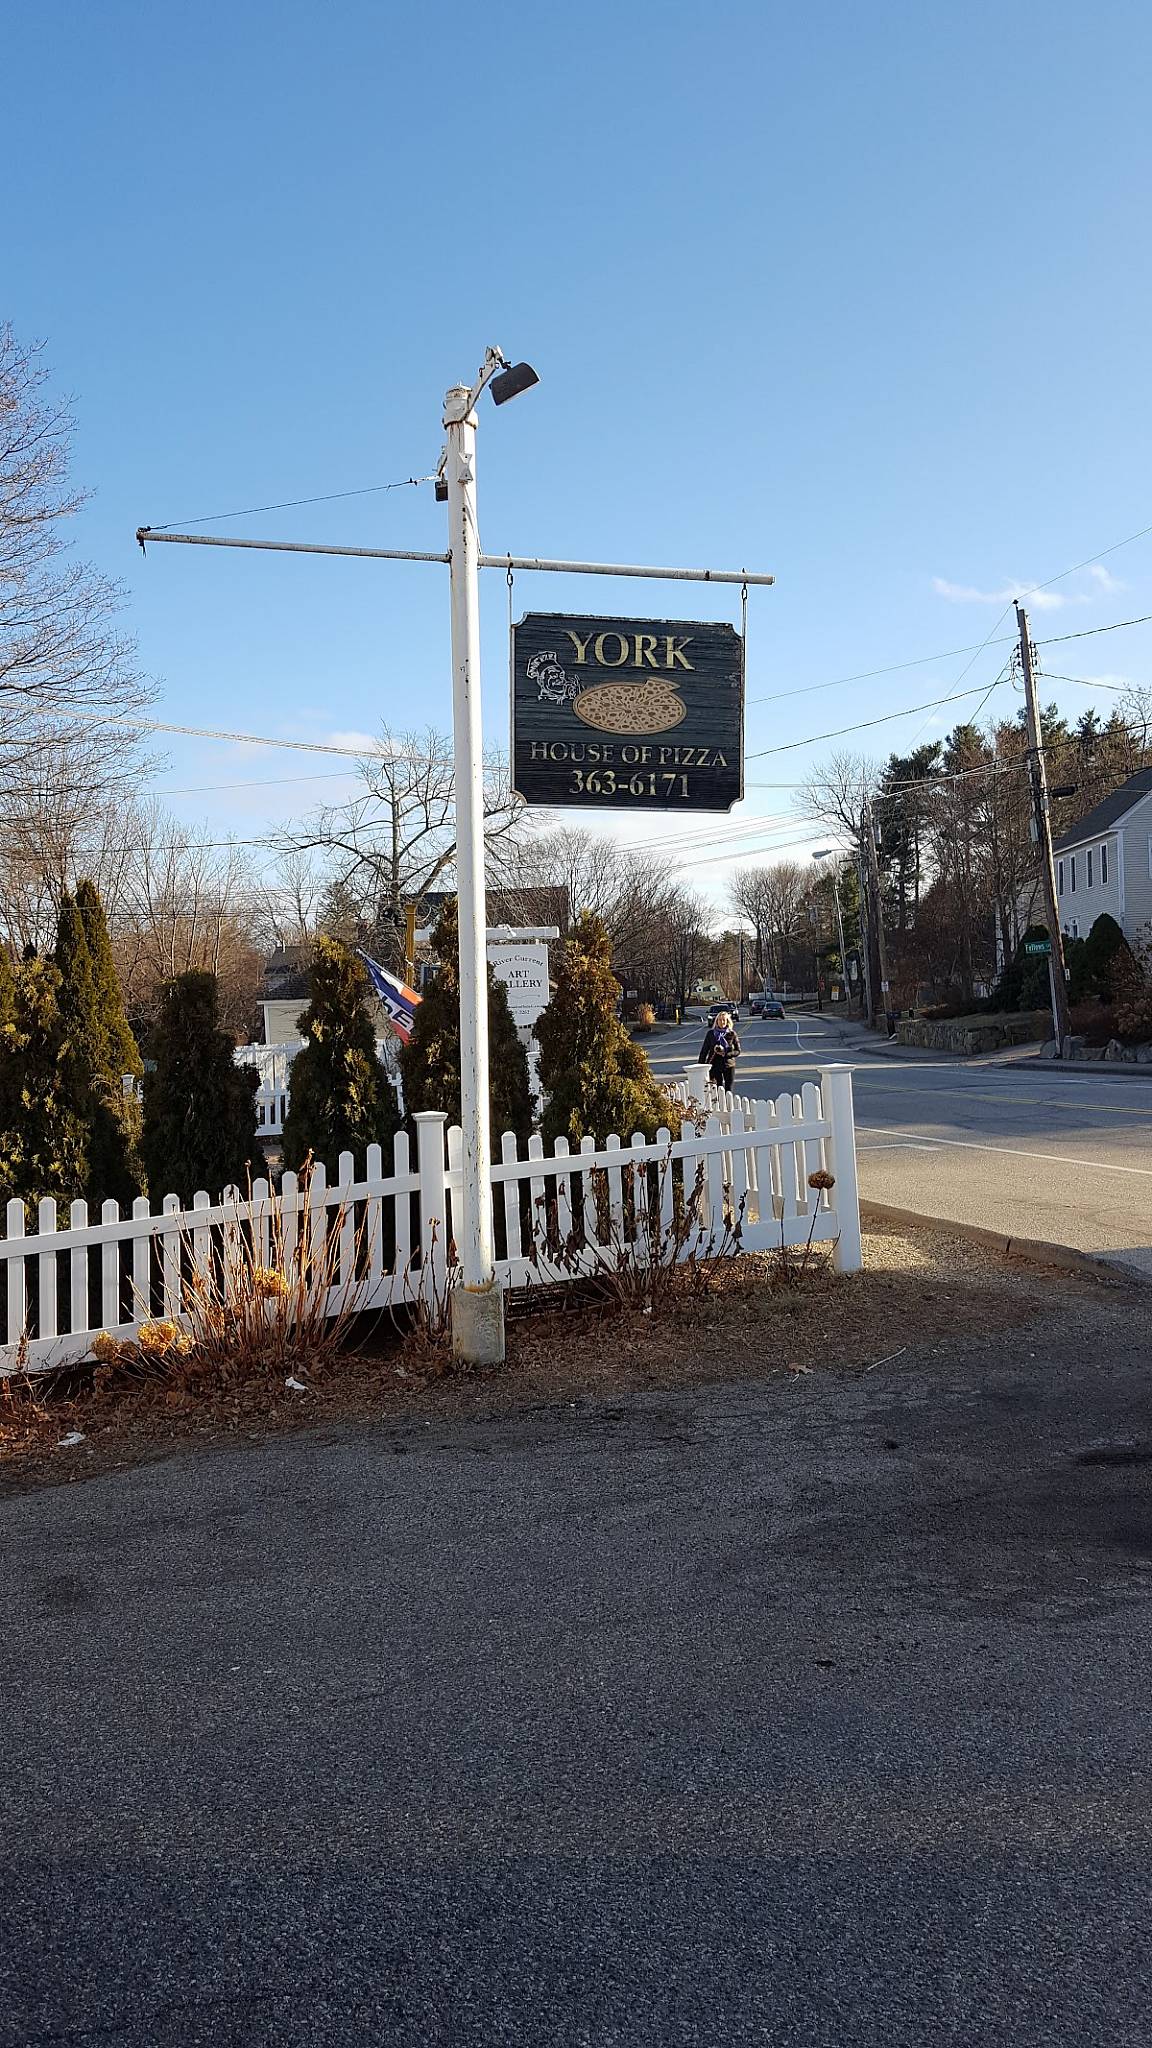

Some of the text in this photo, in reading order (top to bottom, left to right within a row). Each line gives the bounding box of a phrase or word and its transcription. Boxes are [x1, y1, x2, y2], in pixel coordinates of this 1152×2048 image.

[566, 630, 695, 671] YORK
[530, 741, 728, 767] HOUSE OF PIZZA
[569, 770, 691, 798] 363-6171
[492, 955, 544, 967] River Current
[508, 970, 529, 978] ART
